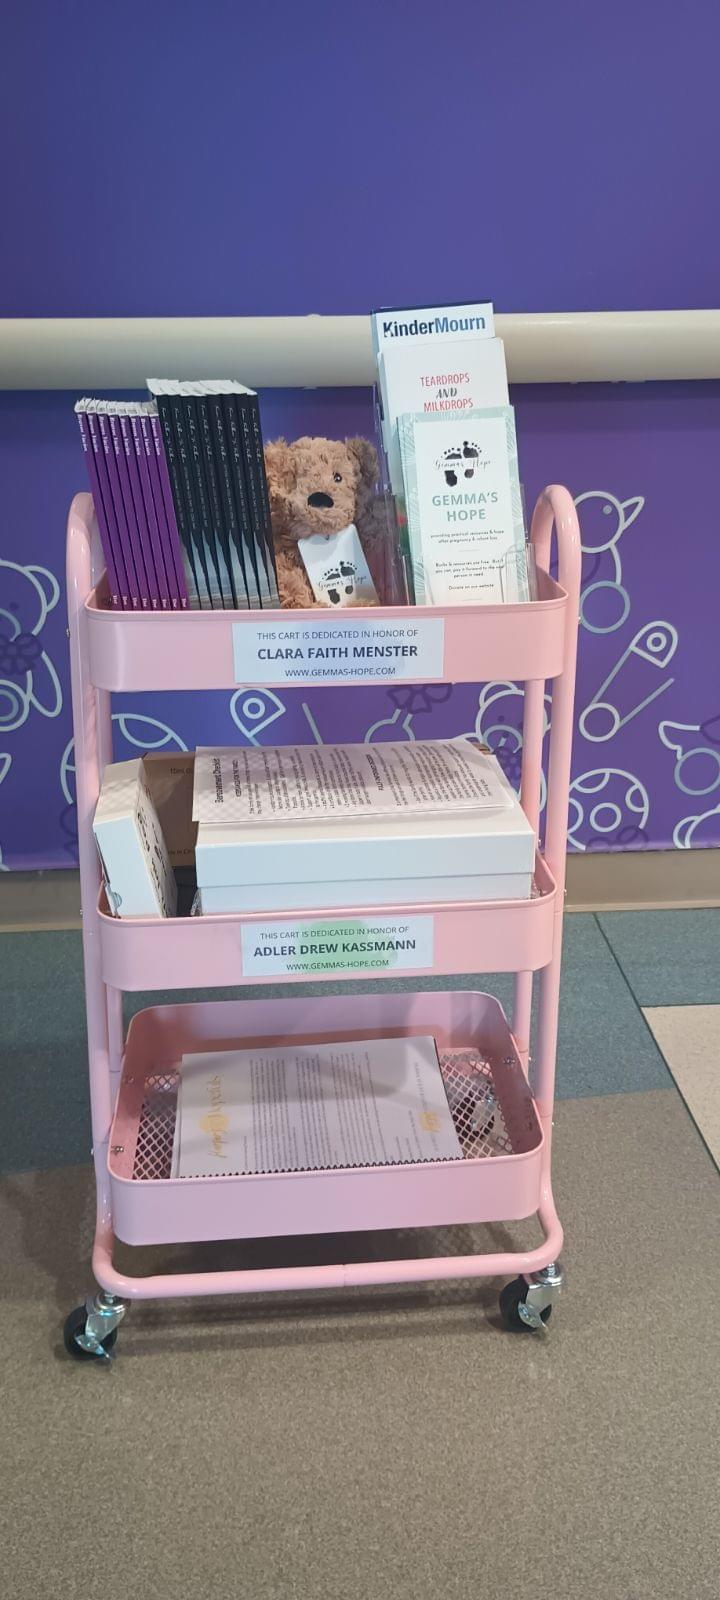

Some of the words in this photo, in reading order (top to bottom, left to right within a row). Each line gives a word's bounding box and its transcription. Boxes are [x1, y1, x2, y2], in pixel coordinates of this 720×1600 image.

[383, 317, 486, 337] KinderMourn
[420, 373, 470, 387] TEARDROPS
[436, 387, 457, 399] AND
[424, 398, 474, 412] MILKDROPS
[432, 491, 498, 507] GEMMA'S
[446, 508, 486, 522] HOPE
[257, 632, 277, 640] THIS
[278, 631, 300, 640] CART
[302, 631, 310, 639] IS
[312, 630, 359, 639] DEDICATED
[361, 630, 371, 638] IN
[372, 629, 405, 638] HONOR
[406, 629, 419, 637] OF
[257, 648, 304, 660] CLARA
[308, 647, 348, 659] FAITH
[353, 645, 418, 658] MENSTER
[284, 667, 396, 677] WWW.GEMMAS-HOPE.COM
[260, 932, 278, 940] THIS
[279, 931, 299, 939] CART
[302, 930, 309, 938] IS
[310, 928, 355, 938] DEDICATED
[357, 928, 365, 936] IN
[367, 926, 397, 935] HONOR
[399, 926, 409, 934] OF
[254, 945, 297, 957] ADLER
[300, 943, 338, 955] DREW
[342, 939, 416, 953] KASSMANN
[286, 959, 389, 971] WWW.GEMMAS-HOPE.COM
